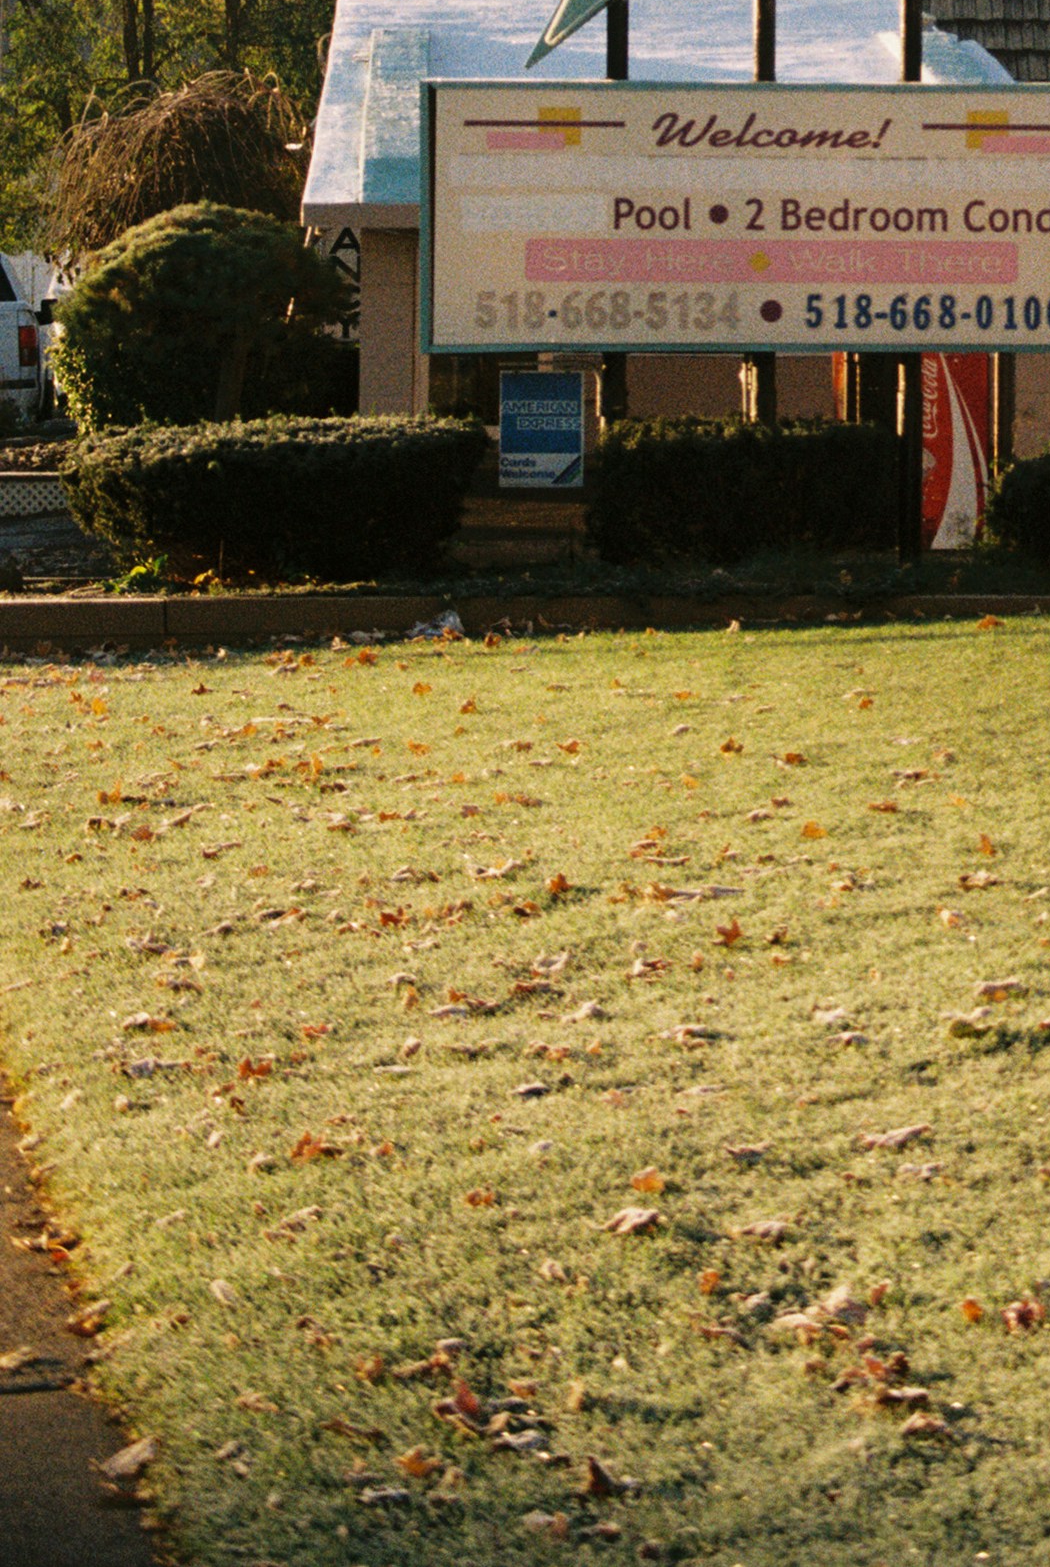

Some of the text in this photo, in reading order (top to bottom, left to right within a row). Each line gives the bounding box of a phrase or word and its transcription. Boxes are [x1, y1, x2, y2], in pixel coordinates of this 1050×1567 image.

[652, 112, 893, 149] Welcome!
[613, 196, 692, 231] Pool
[744, 198, 765, 231] 2
[780, 198, 949, 233] Bedroom
[542, 247, 1004, 276] Stay Here Walk There
[500, 400, 579, 414] AMERICAN
[517, 416, 582, 431] EXPRESS
[500, 457, 537, 468] Cards
[500, 468, 557, 479] Welcome
